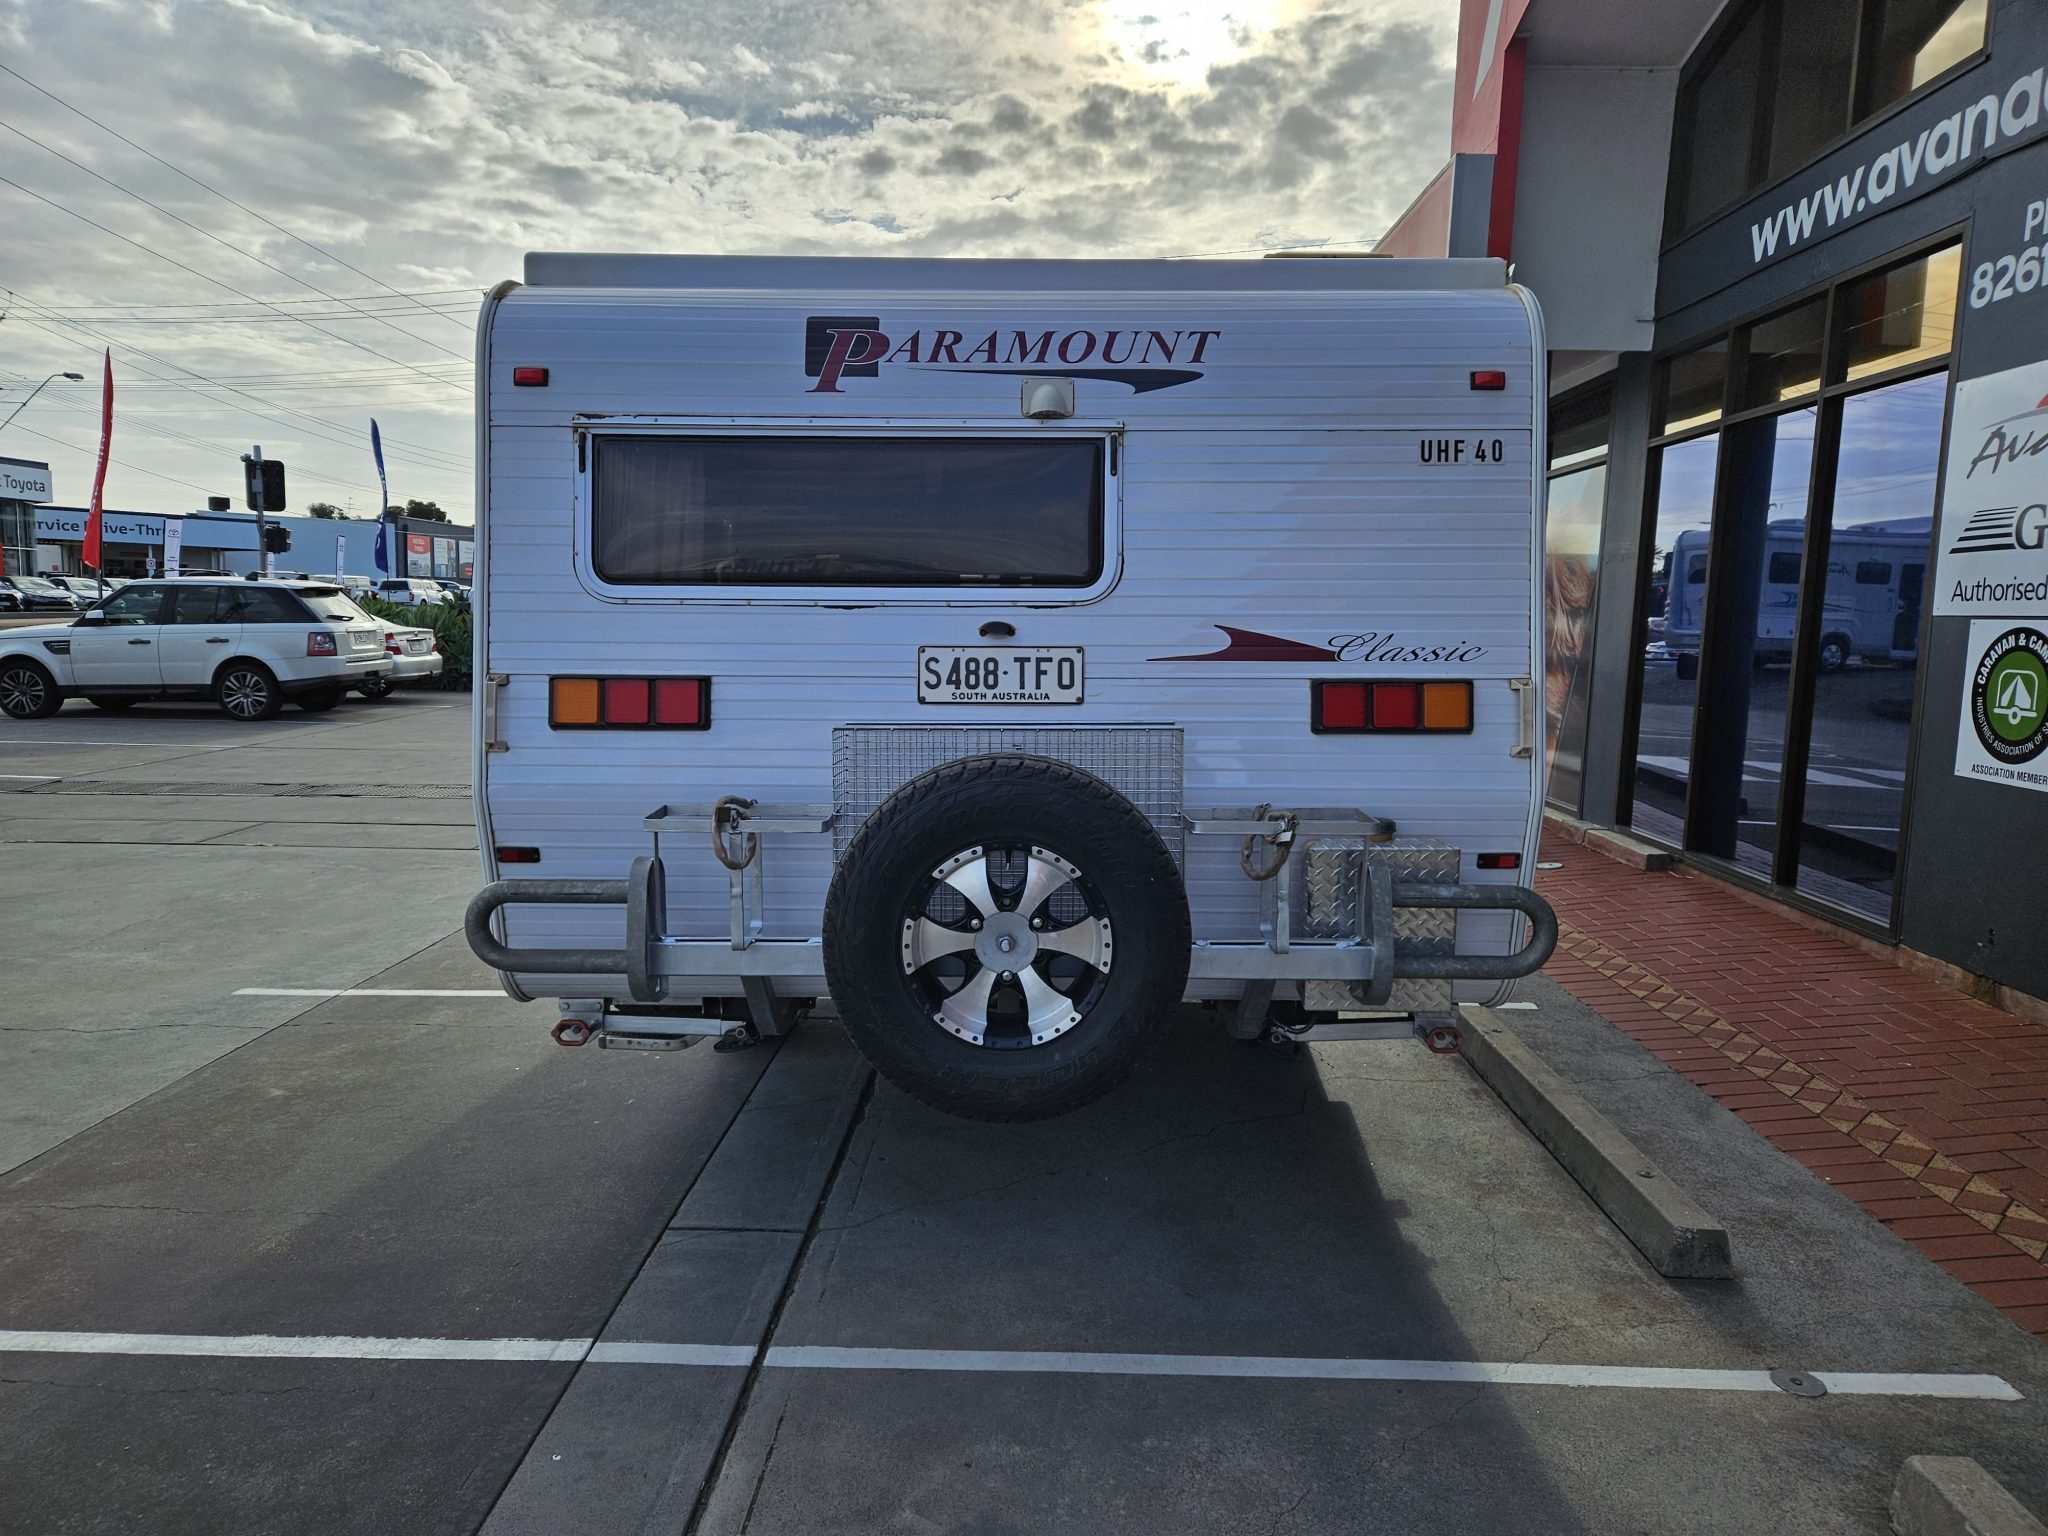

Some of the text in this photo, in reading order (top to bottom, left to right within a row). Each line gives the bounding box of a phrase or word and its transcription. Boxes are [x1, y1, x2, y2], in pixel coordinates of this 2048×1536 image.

[1751, 67, 2048, 263] www.avana
[804, 328, 1220, 393] PARAMOUNT
[1421, 439, 1503, 462] UHF 40
[3, 474, 45, 493] Toyota
[1951, 574, 2048, 602] Authorised
[1328, 632, 1488, 662] Classic
[1977, 634, 2016, 685] CARAVAN
[2019, 633, 2027, 646] &
[951, 692, 1050, 700] SOUTH AUSTRALIA
[1977, 697, 1995, 743] INDUSTRIES
[1993, 740, 2034, 756] ASSOCIATION
[2034, 732, 2044, 745] OF
[1972, 763, 2048, 786] ASSOCIATION MEMBER
